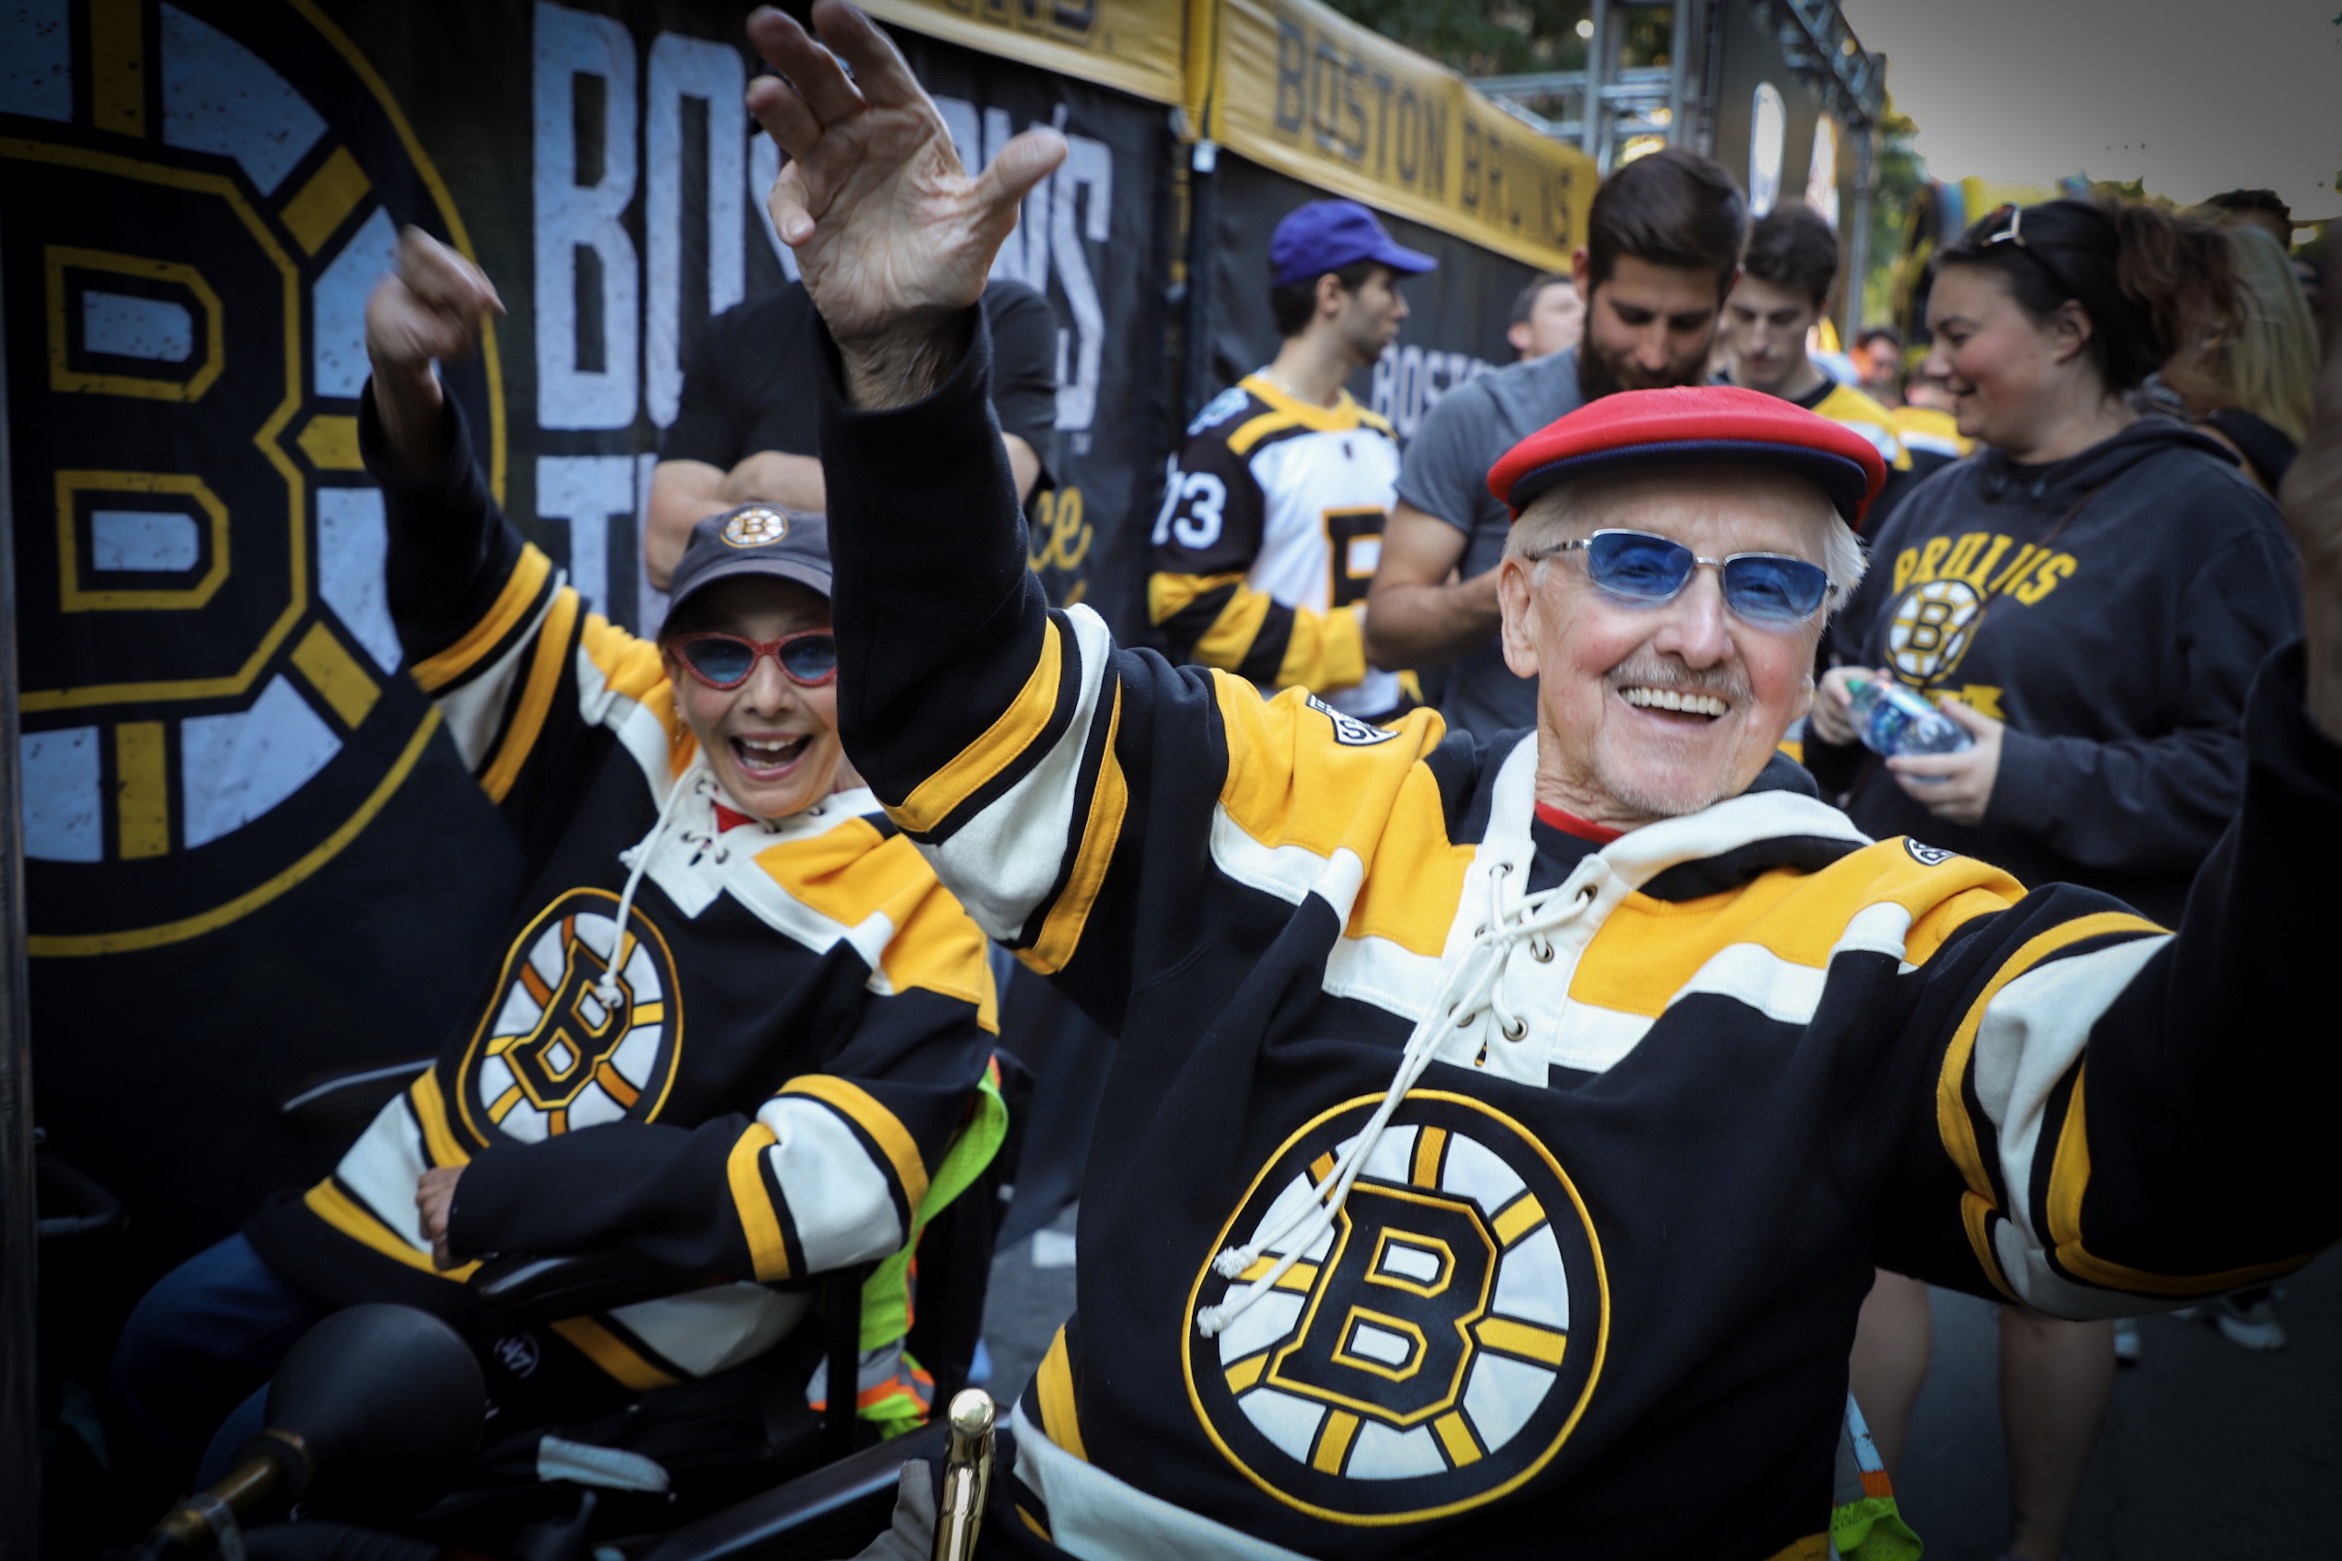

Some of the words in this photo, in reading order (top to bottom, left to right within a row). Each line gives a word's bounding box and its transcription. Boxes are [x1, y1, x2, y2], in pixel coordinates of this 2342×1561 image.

[1276, 16, 1448, 198] BOSTON
[1462, 115, 1574, 249] BRUNS
[505, 936, 634, 1110] B
[1266, 1182, 1499, 1427] B
